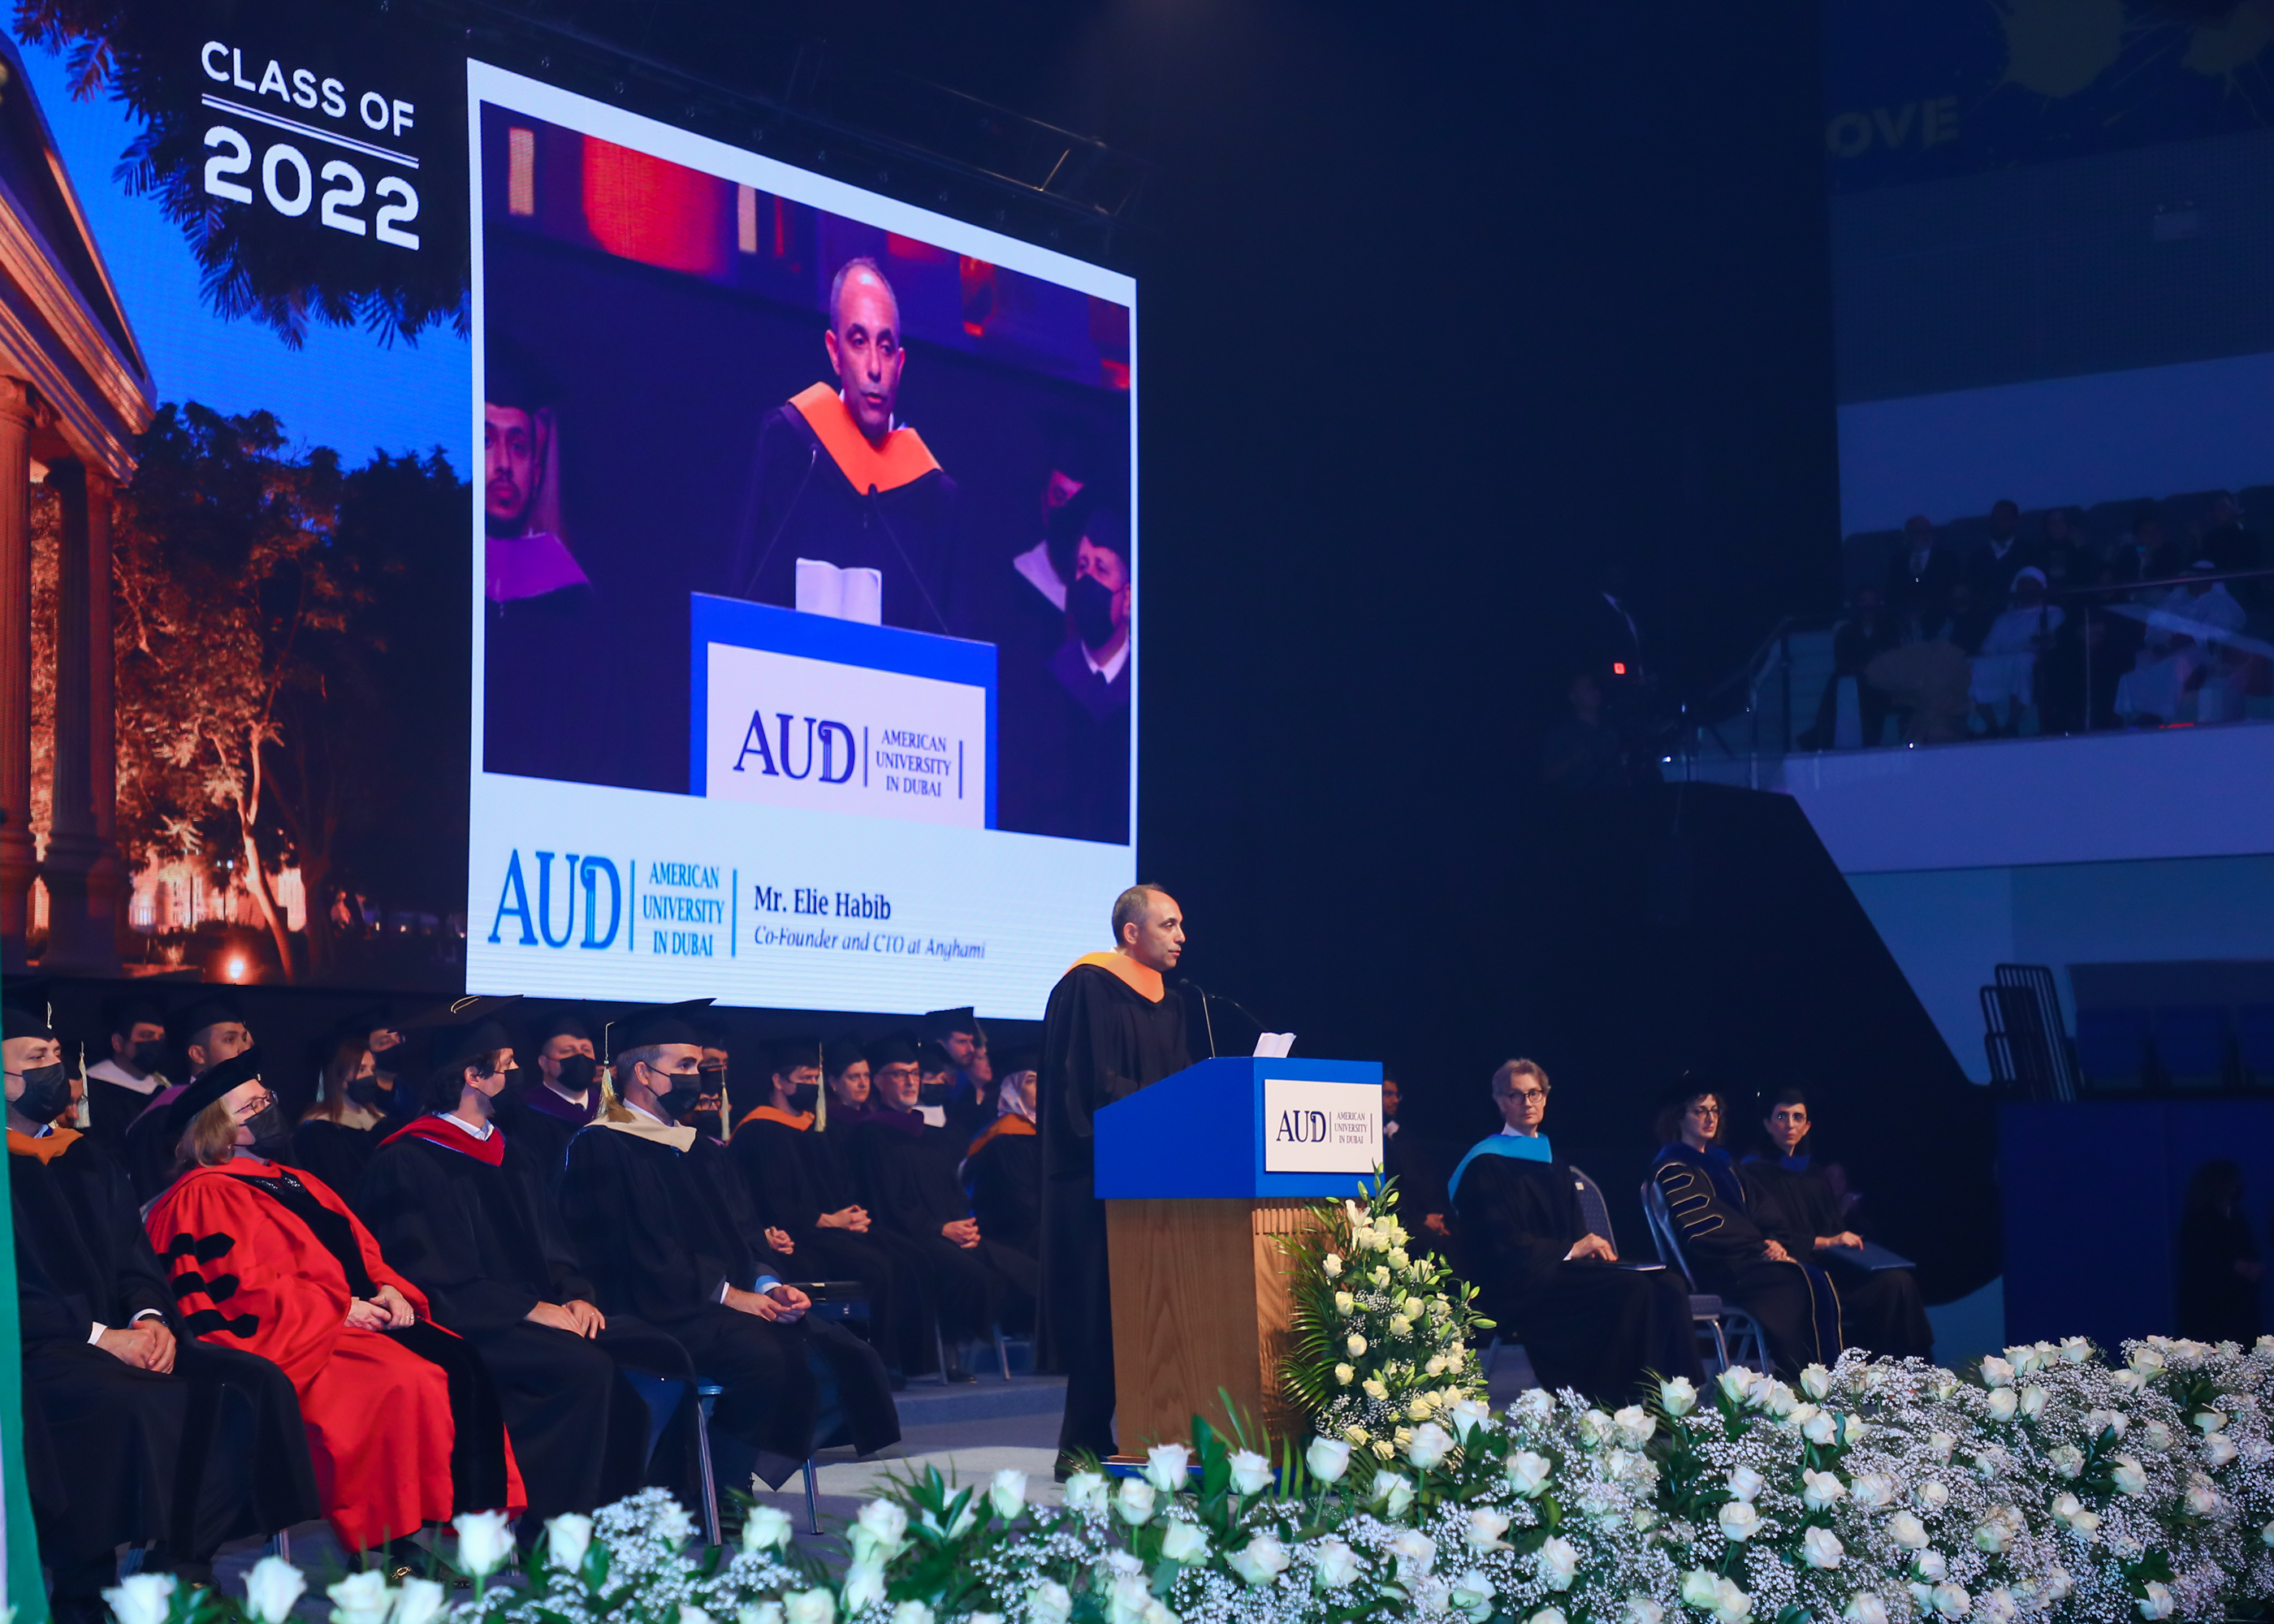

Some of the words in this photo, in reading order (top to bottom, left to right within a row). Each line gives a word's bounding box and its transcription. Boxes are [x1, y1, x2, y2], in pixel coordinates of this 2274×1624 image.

[201, 41, 347, 118] CLASS
[360, 91, 415, 137] OF
[204, 125, 420, 251] 2022
[733, 709, 855, 784] AUD
[881, 729, 946, 753] AMERICAN
[876, 750, 951, 776] UNIVERSITY
[886, 775, 899, 792] IN
[903, 777, 941, 797] DUBAI
[649, 862, 720, 889] AMERICAN
[487, 848, 621, 950] AUD
[642, 894, 724, 924] UNIVERSITY
[754, 884, 787, 913] Mr.
[793, 888, 829, 915] Elie
[835, 892, 891, 920] Habib
[653, 931, 668, 954] IN
[672, 933, 713, 957] DUBAI
[754, 925, 838, 950] Co-Founder
[841, 931, 870, 952] and
[873, 933, 904, 953] CTO
[907, 938, 921, 955] at
[924, 938, 986, 961] Anghami
[1276, 1110, 1326, 1142] AUD
[1334, 1123, 1368, 1133] UNIVERSITY
[1336, 1112, 1365, 1121] AMERICAN
[1338, 1135, 1345, 1144] IN
[1346, 1135, 1364, 1144] DUBAI
